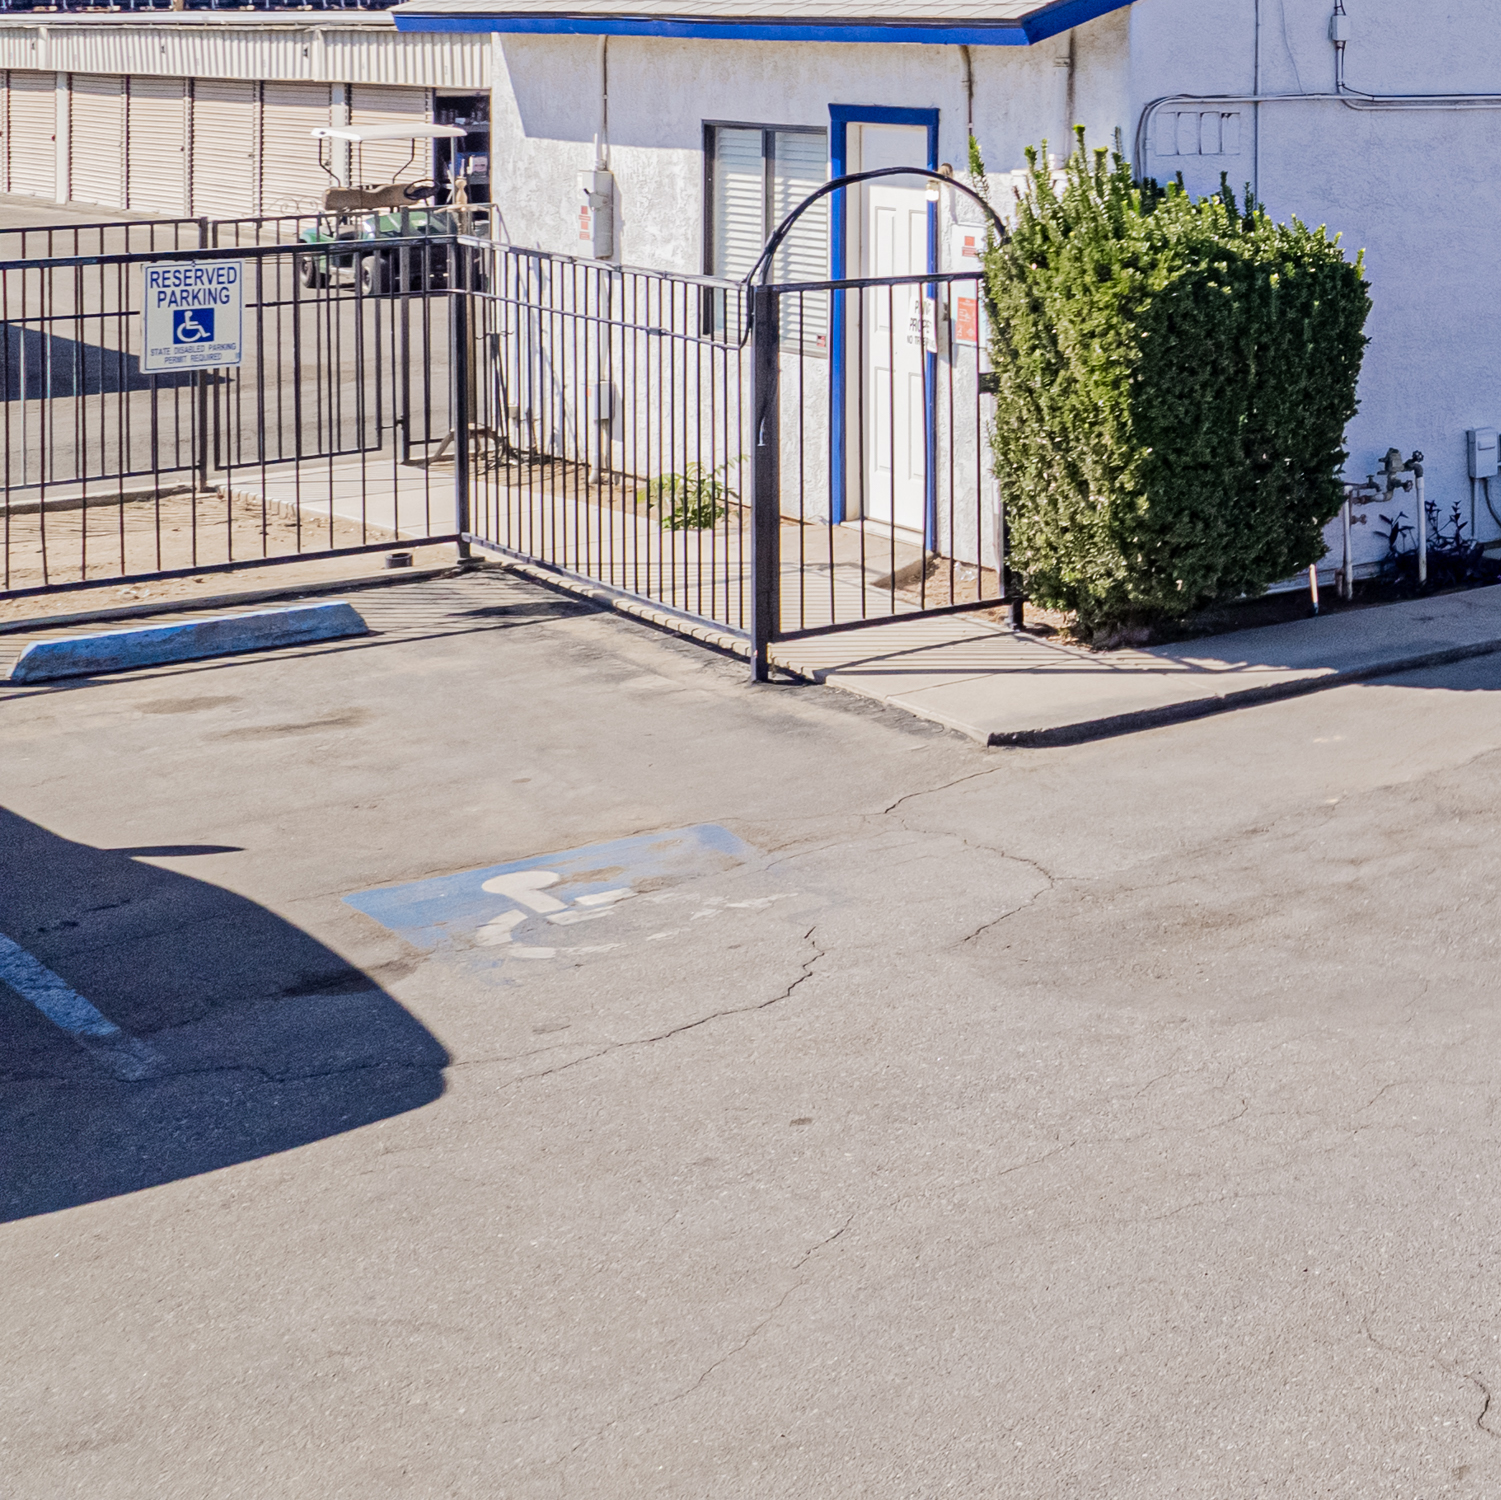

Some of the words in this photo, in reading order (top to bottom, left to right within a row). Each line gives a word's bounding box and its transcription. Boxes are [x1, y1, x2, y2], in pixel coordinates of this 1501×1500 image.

[150, 266, 237, 289] RESERVED
[157, 286, 230, 309] PARKING
[150, 347, 170, 357] STATE
[174, 344, 205, 355] DISABLED
[208, 342, 237, 351] PARKING
[164, 355, 187, 364] PERMIT
[190, 352, 222, 363] REQUIRED
